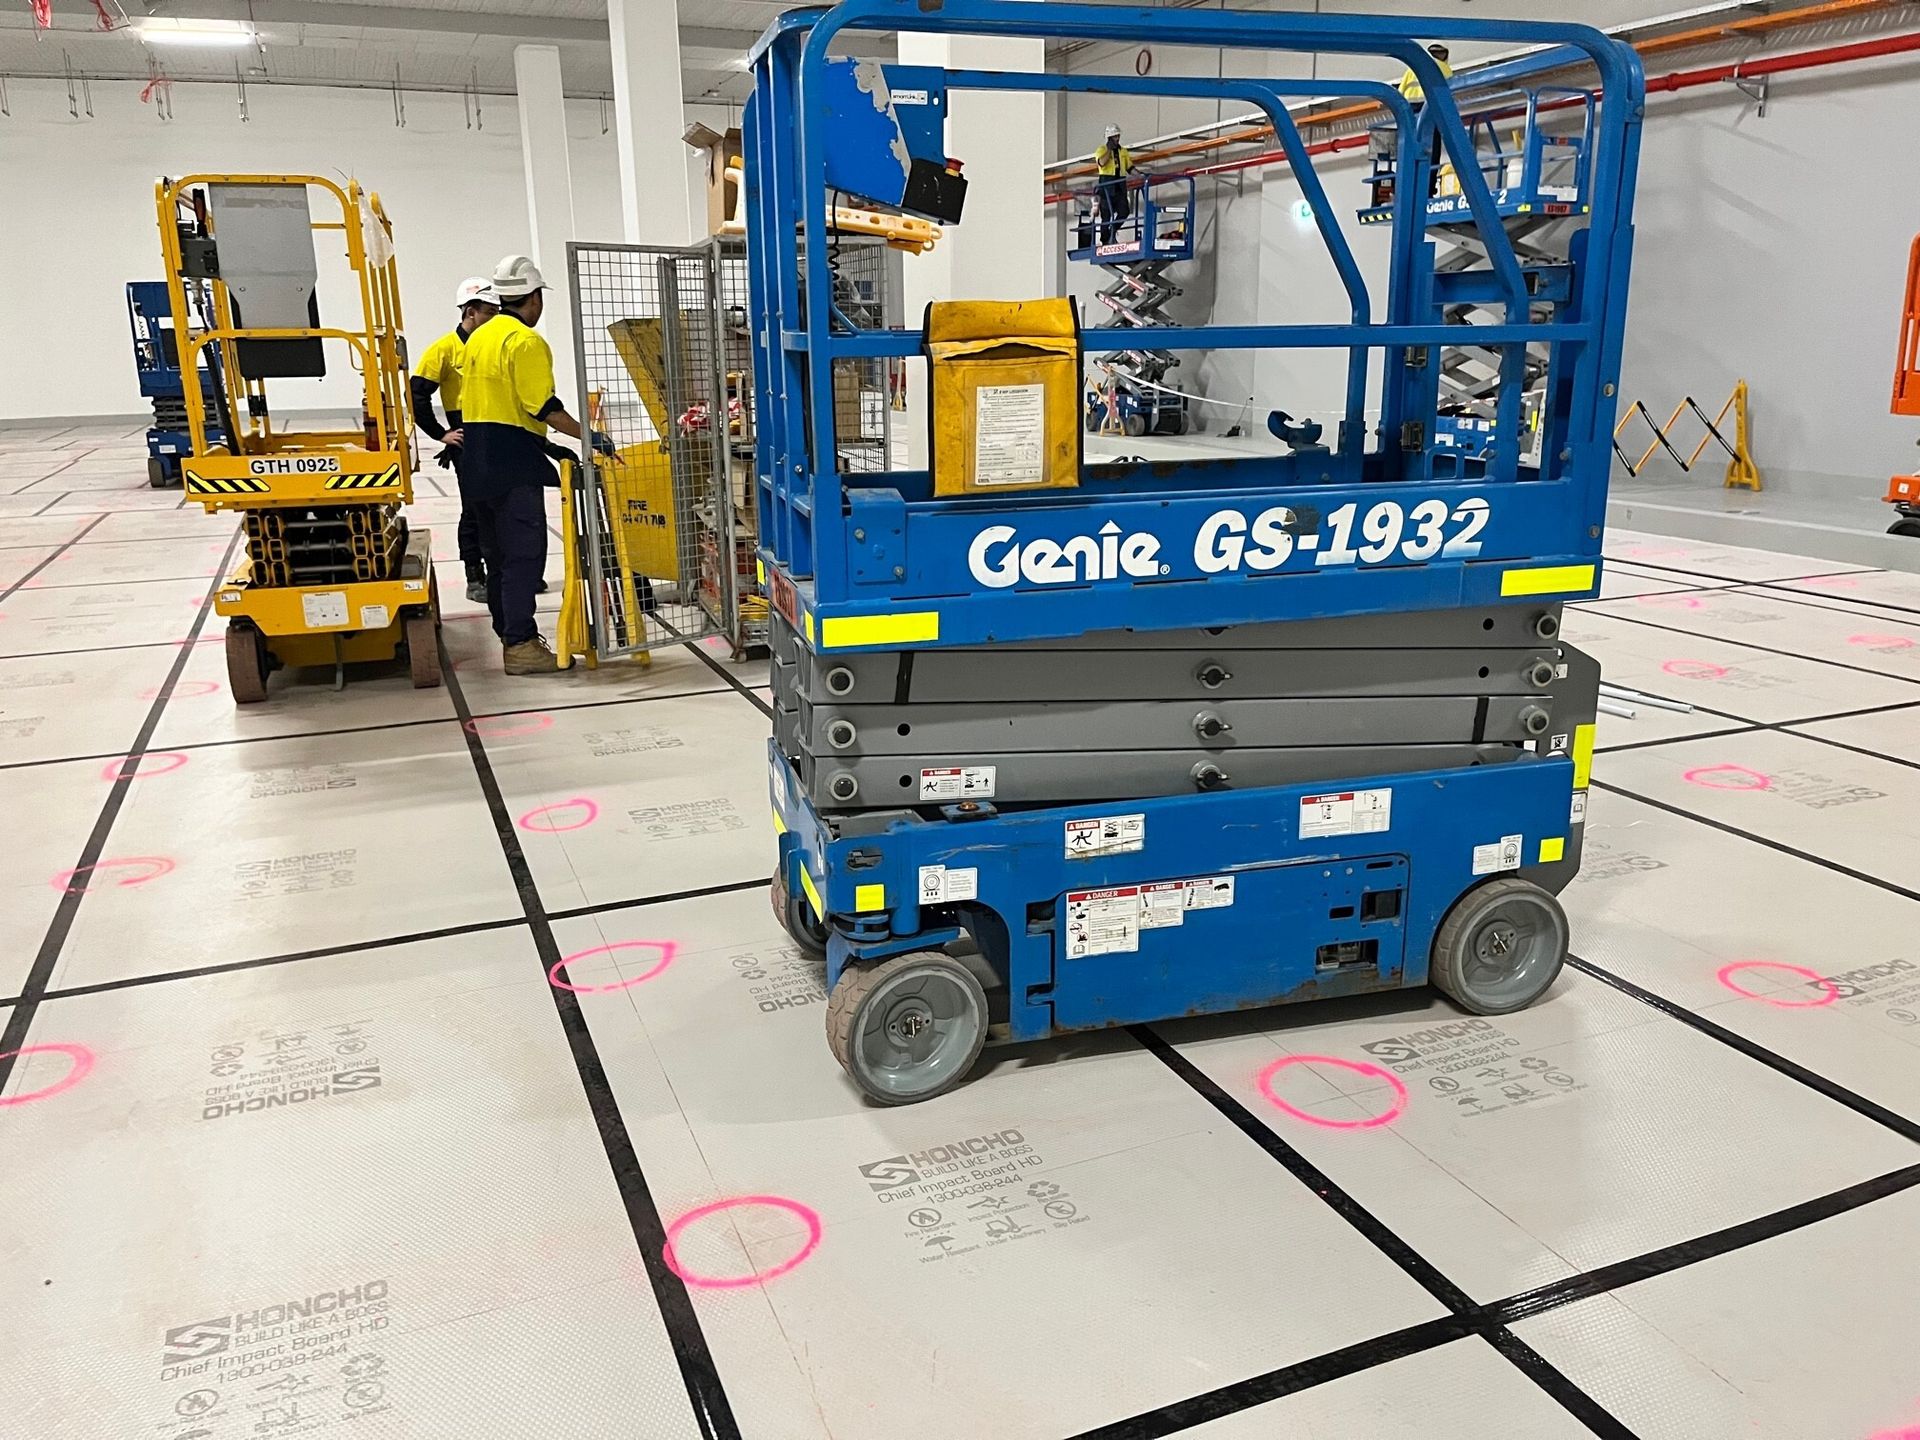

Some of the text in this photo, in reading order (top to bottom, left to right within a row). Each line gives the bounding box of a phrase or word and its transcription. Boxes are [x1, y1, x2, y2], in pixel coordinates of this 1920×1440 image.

[251, 457, 338, 474] GTH 0925
[968, 497, 1490, 588] Genie GS-1932
[659, 798, 730, 813] HONCHO
[274, 848, 357, 865] HONCHO
[1092, 890, 1119, 898] DANGER
[758, 990, 829, 1013] NCHO
[1400, 1018, 1493, 1049] HONCHO
[289, 1075, 329, 1090] BUILD
[202, 1084, 331, 1120] HONCHO
[909, 1128, 1025, 1169] HONCHO
[921, 1144, 1034, 1179] BUILD LIKE A BOSS
[877, 1155, 1043, 1205] Chief Impact Board HD
[926, 1173, 1023, 1206] 1300-038-244
[235, 1279, 389, 1333] HONCHO
[235, 1301, 389, 1348] BUILD LIKE A BOSS
[160, 1315, 390, 1382] Chief Impact Board HD
[215, 1342, 349, 1385] 1300-038-244
